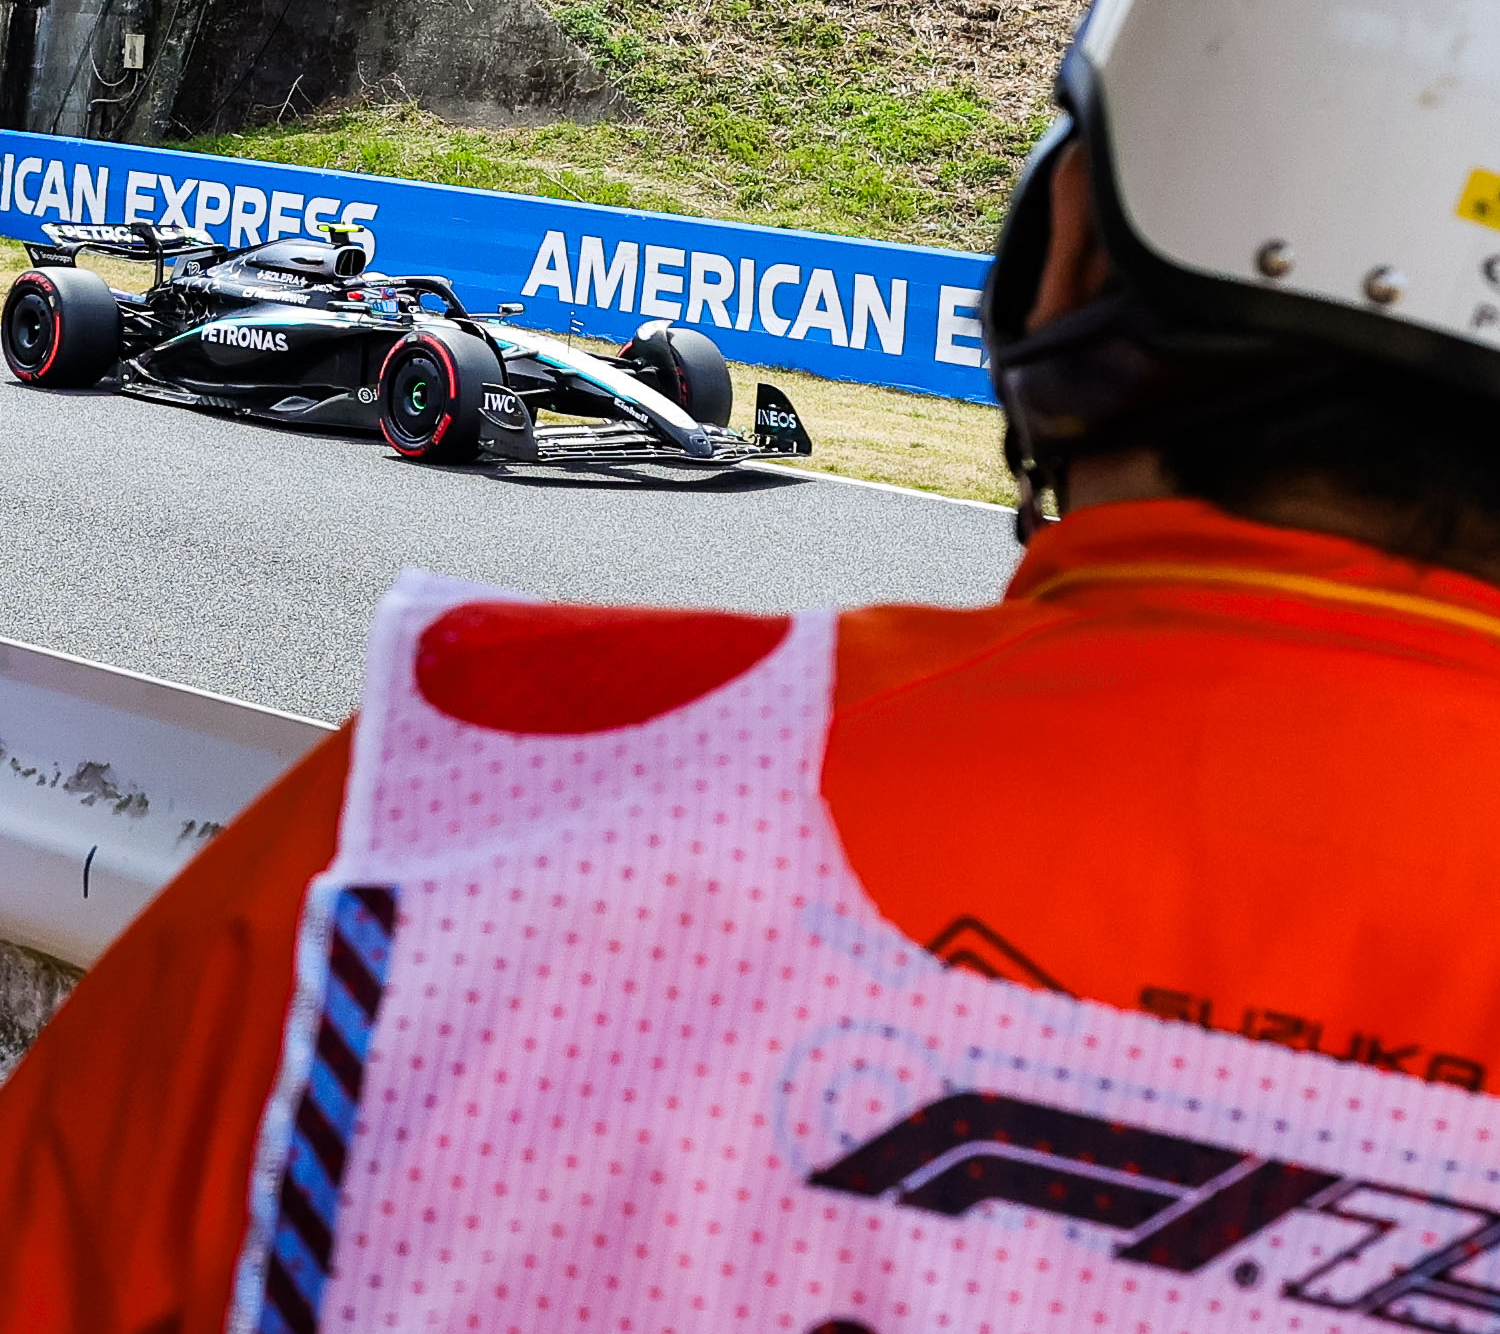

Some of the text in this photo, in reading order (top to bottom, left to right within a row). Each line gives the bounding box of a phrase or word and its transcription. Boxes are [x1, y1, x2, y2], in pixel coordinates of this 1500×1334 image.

[124, 169, 379, 263] EXPRESS
[263, 270, 300, 287] SOLERA
[521, 229, 908, 357] AMERICAN
[201, 323, 289, 353] PETRONAS
[483, 392, 516, 414] IWC
[757, 408, 797, 429] INEOS
